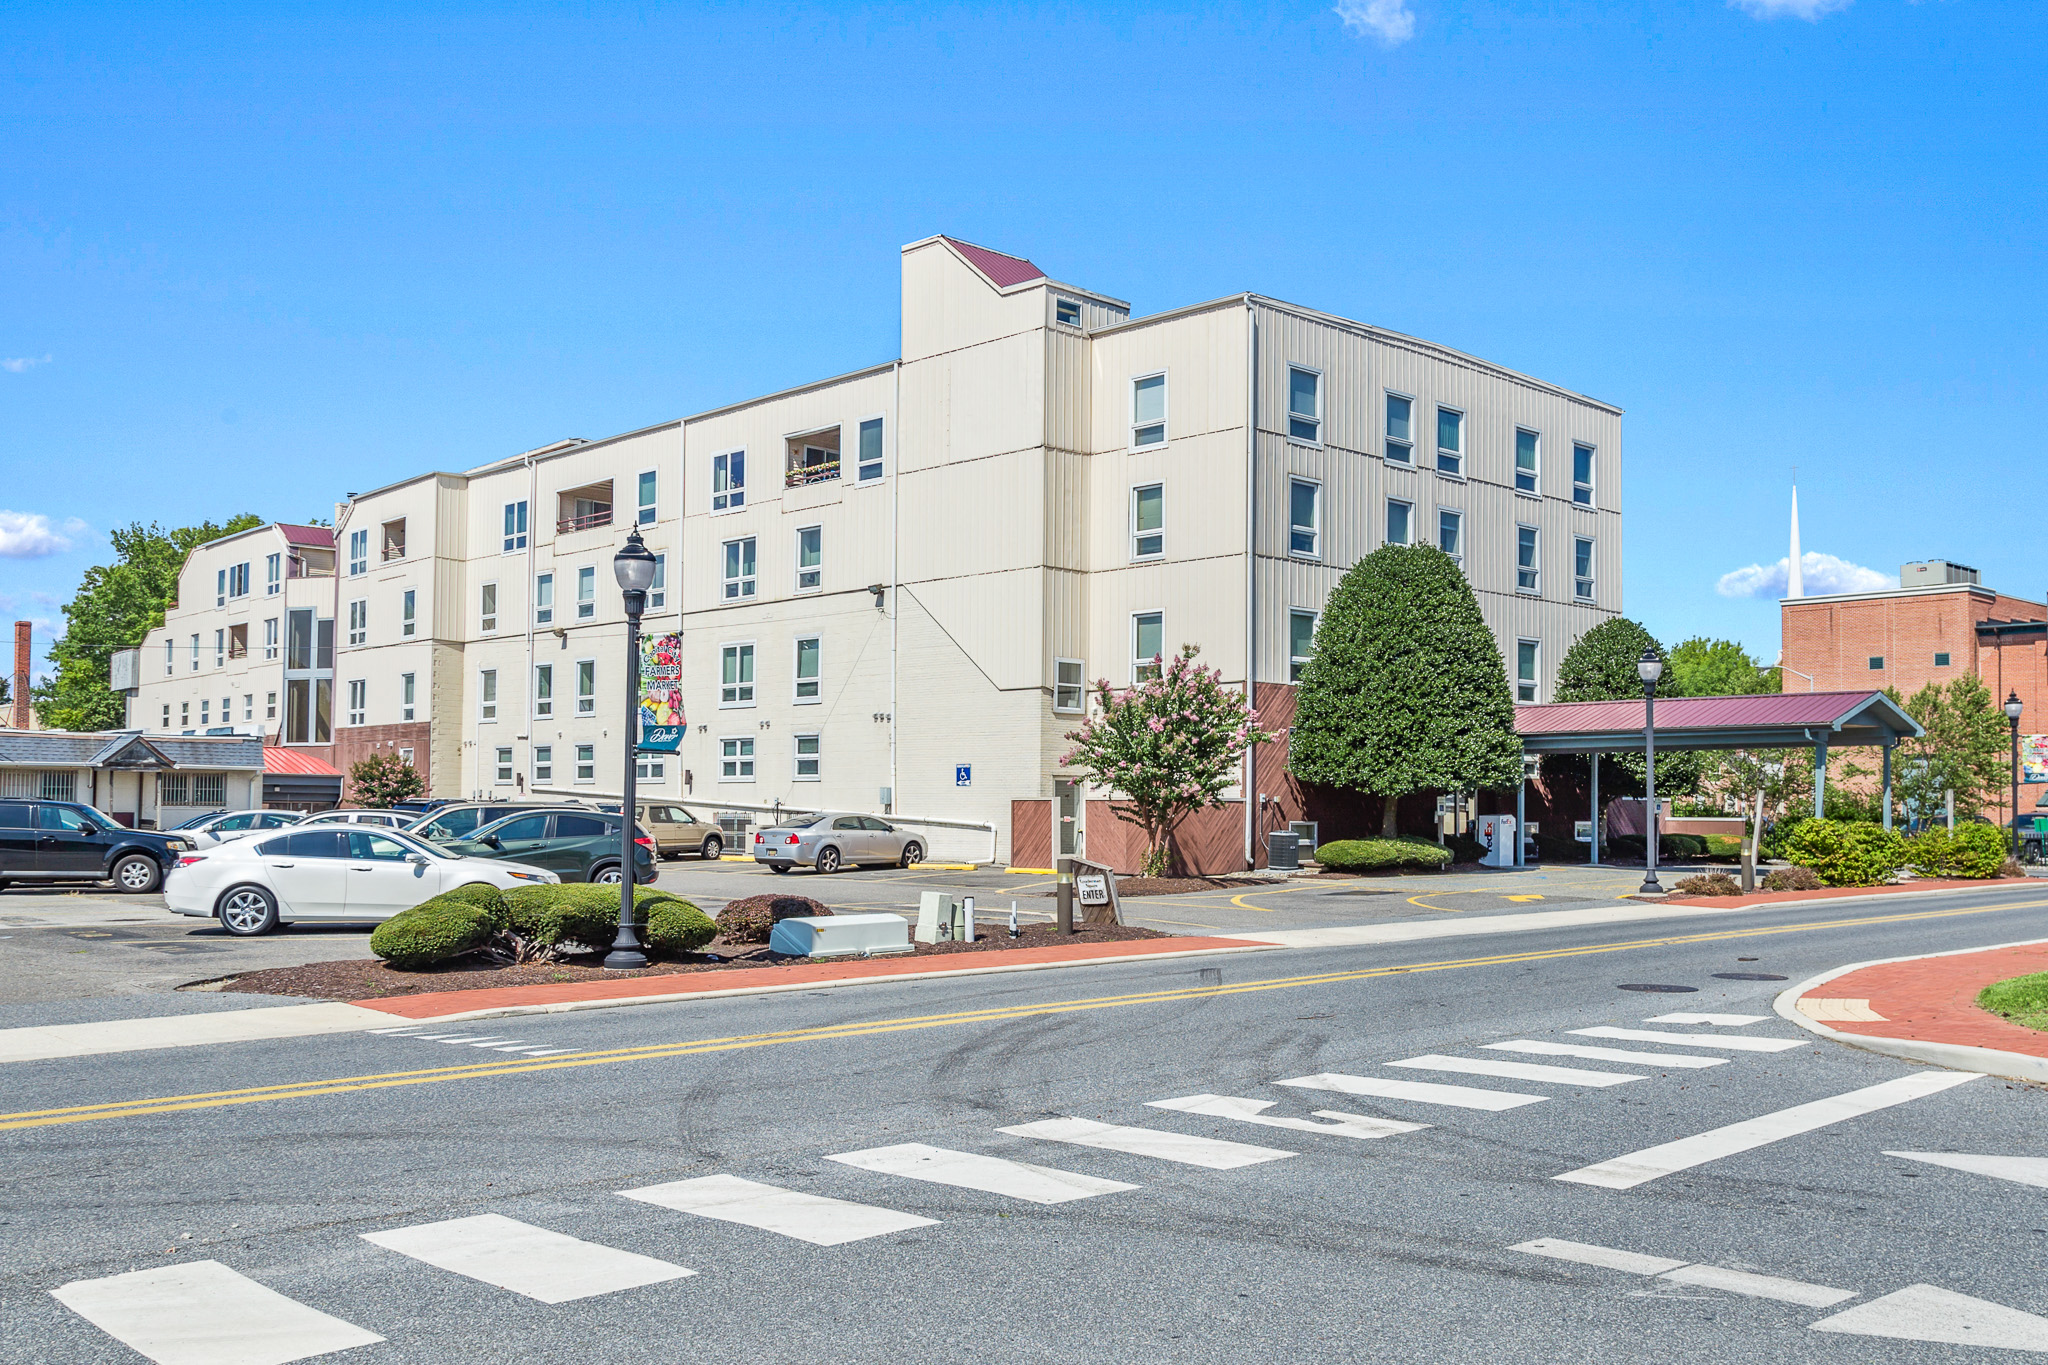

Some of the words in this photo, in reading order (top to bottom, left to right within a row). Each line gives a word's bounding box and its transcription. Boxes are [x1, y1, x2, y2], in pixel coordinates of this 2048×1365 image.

[645, 665, 679, 676] FARMERS
[646, 680, 678, 690] MARKET
[1082, 889, 1105, 900] ENTER
